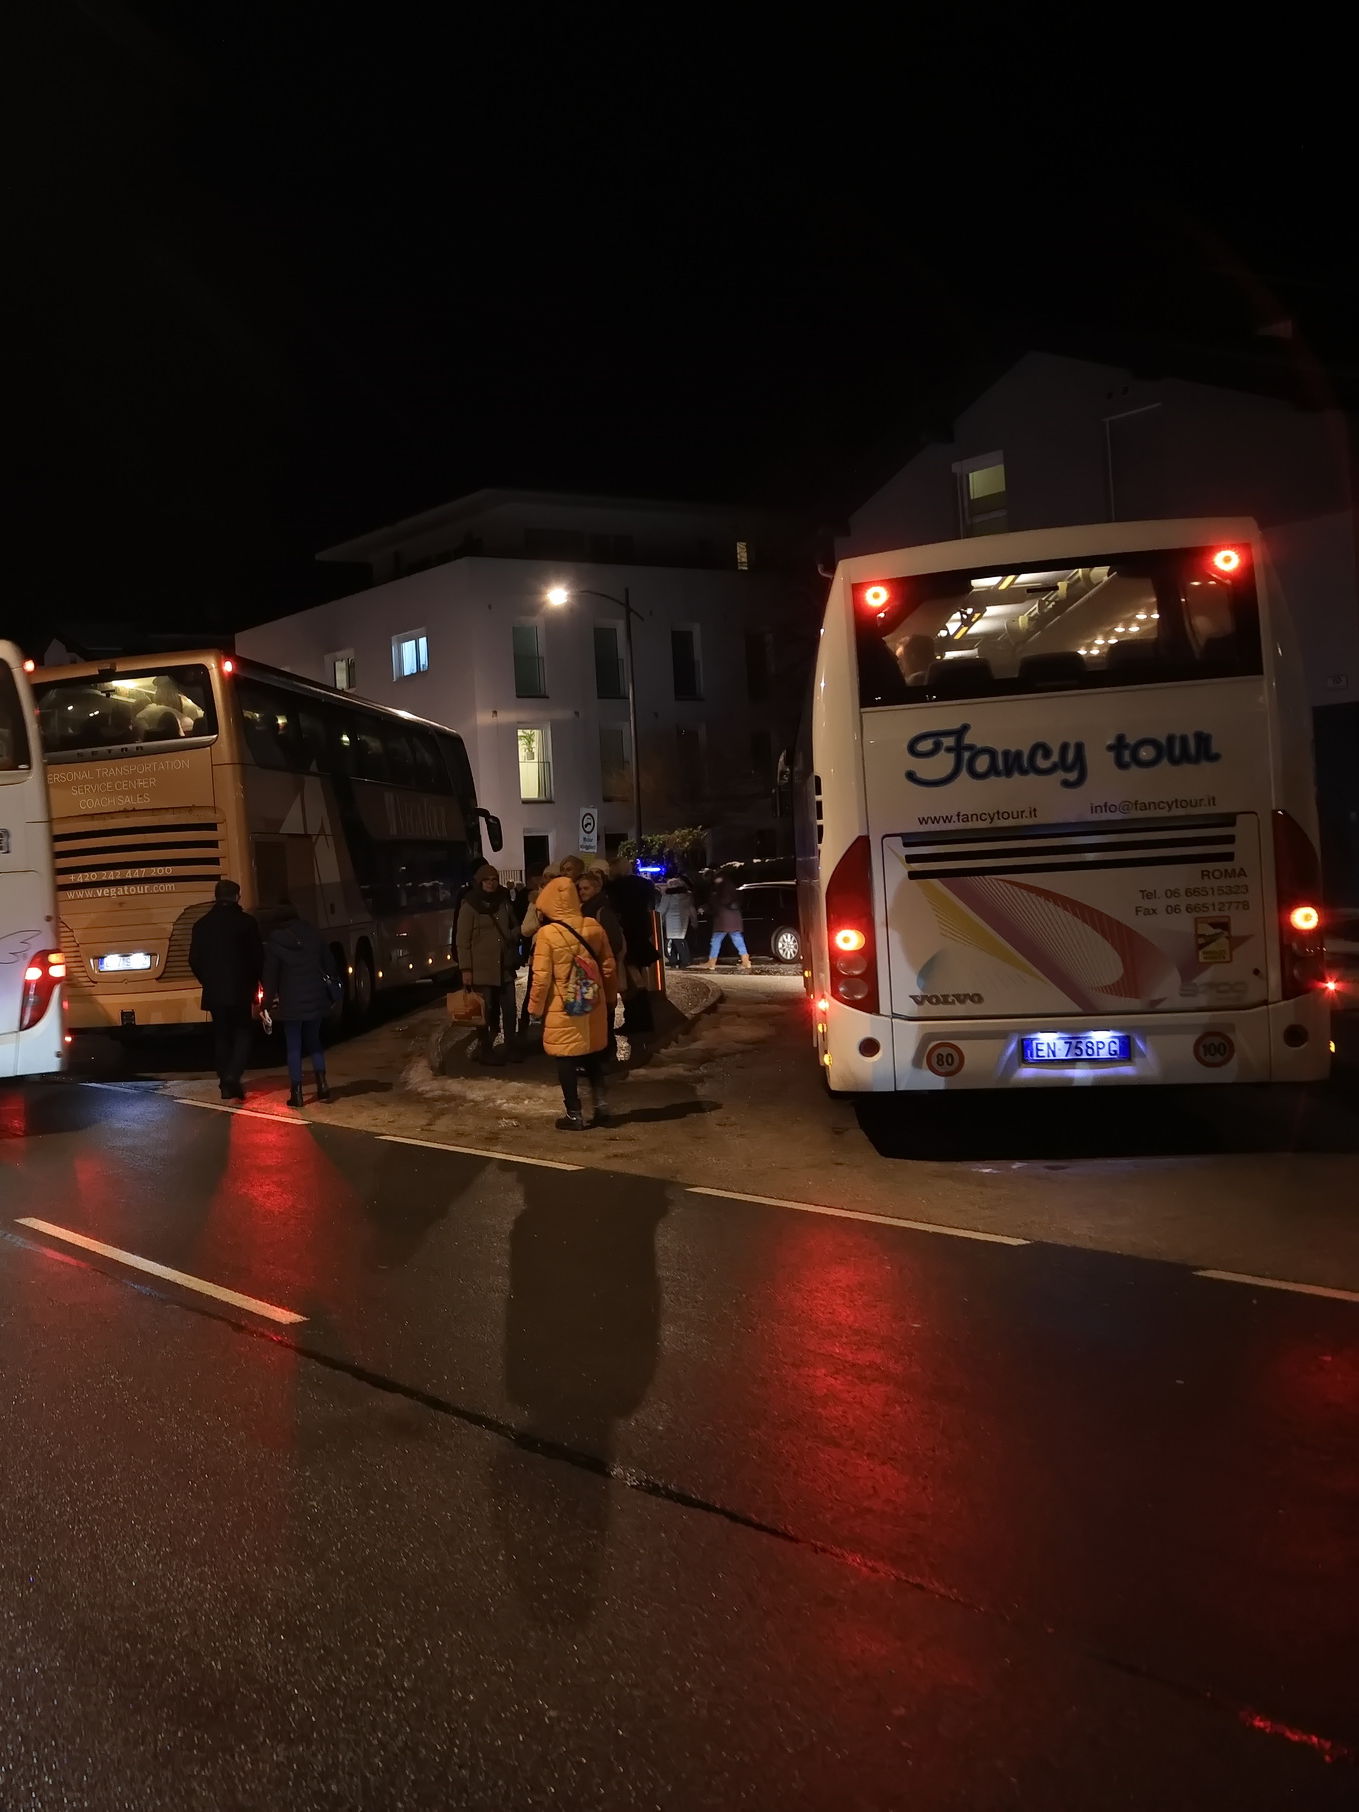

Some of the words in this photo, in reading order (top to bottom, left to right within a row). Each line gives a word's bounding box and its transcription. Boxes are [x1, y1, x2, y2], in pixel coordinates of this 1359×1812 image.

[77, 746, 144, 758] SETRA
[905, 723, 1088, 789] Fancy
[1106, 730, 1222, 770] tour
[47, 769, 93, 784] ERSONAL
[96, 759, 190, 778] TRANSPORTATION
[71, 781, 113, 796] SERVICE
[114, 777, 157, 791] CENTER
[79, 797, 115, 810] COACH
[117, 793, 151, 806] SALES
[917, 806, 1038, 827] www.fancytour.it
[1089, 795, 1217, 815] info@fancytour.it
[69, 872, 97, 883] +420
[102, 871, 121, 880] 242
[125, 869, 146, 879] 447
[150, 867, 173, 875] 200
[1200, 867, 1247, 880] ROMA
[66, 883, 175, 899] www.vegatour.com
[1139, 889, 1160, 900] Tel.
[1164, 888, 1181, 899] 06
[1135, 905, 1157, 916] Fax
[1165, 904, 1182, 915] 06
[909, 993, 985, 1006] VOLVO
[1035, 1042, 1057, 1058] EN
[1063, 1040, 1118, 1057] 758PG
[1202, 1041, 1227, 1058] 100
[935, 1052, 955, 1068] 80
